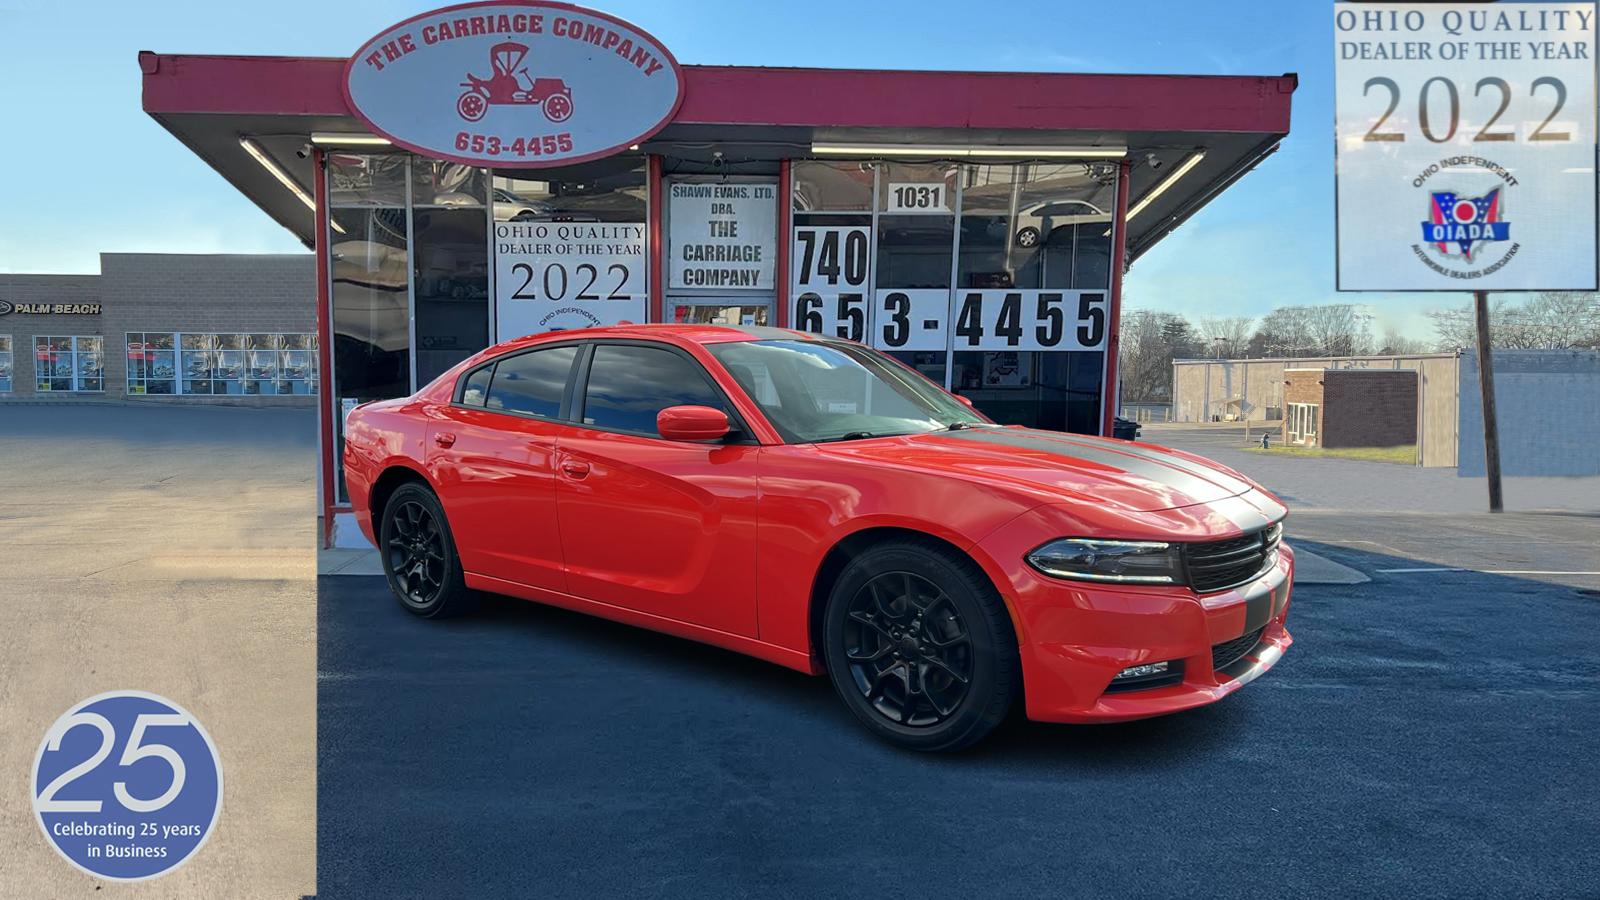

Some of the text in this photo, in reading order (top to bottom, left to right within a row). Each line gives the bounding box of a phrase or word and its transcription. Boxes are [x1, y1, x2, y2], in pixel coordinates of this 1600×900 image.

[1336, 10, 1593, 35] OHIO QUALITY
[366, 14, 664, 77] THE CARRIAGE COMPANY
[1340, 42, 1589, 60] DEALER OF THE YEAR
[1363, 76, 1571, 143] 2022
[455, 132, 573, 156] 653-4455
[1412, 156, 1519, 188] OHIO INDEPENDENT
[672, 186, 712, 199] SHAWN
[894, 187, 941, 208] 1031
[711, 203, 736, 216] DBA.
[497, 226, 645, 242] OHIO QUALITY
[708, 221, 738, 238] THE
[1432, 224, 1496, 241] OIADA
[499, 244, 642, 255] DEALER OF THE YEAR
[683, 245, 762, 262] CARRIAGE
[797, 230, 868, 286] 740
[1450, 270, 1482, 280] DEALERS
[1483, 242, 1521, 276] ASSOCIATION
[510, 263, 632, 301] 2022
[683, 269, 760, 287] COMPANY
[14, 303, 101, 314] PALM BEACH
